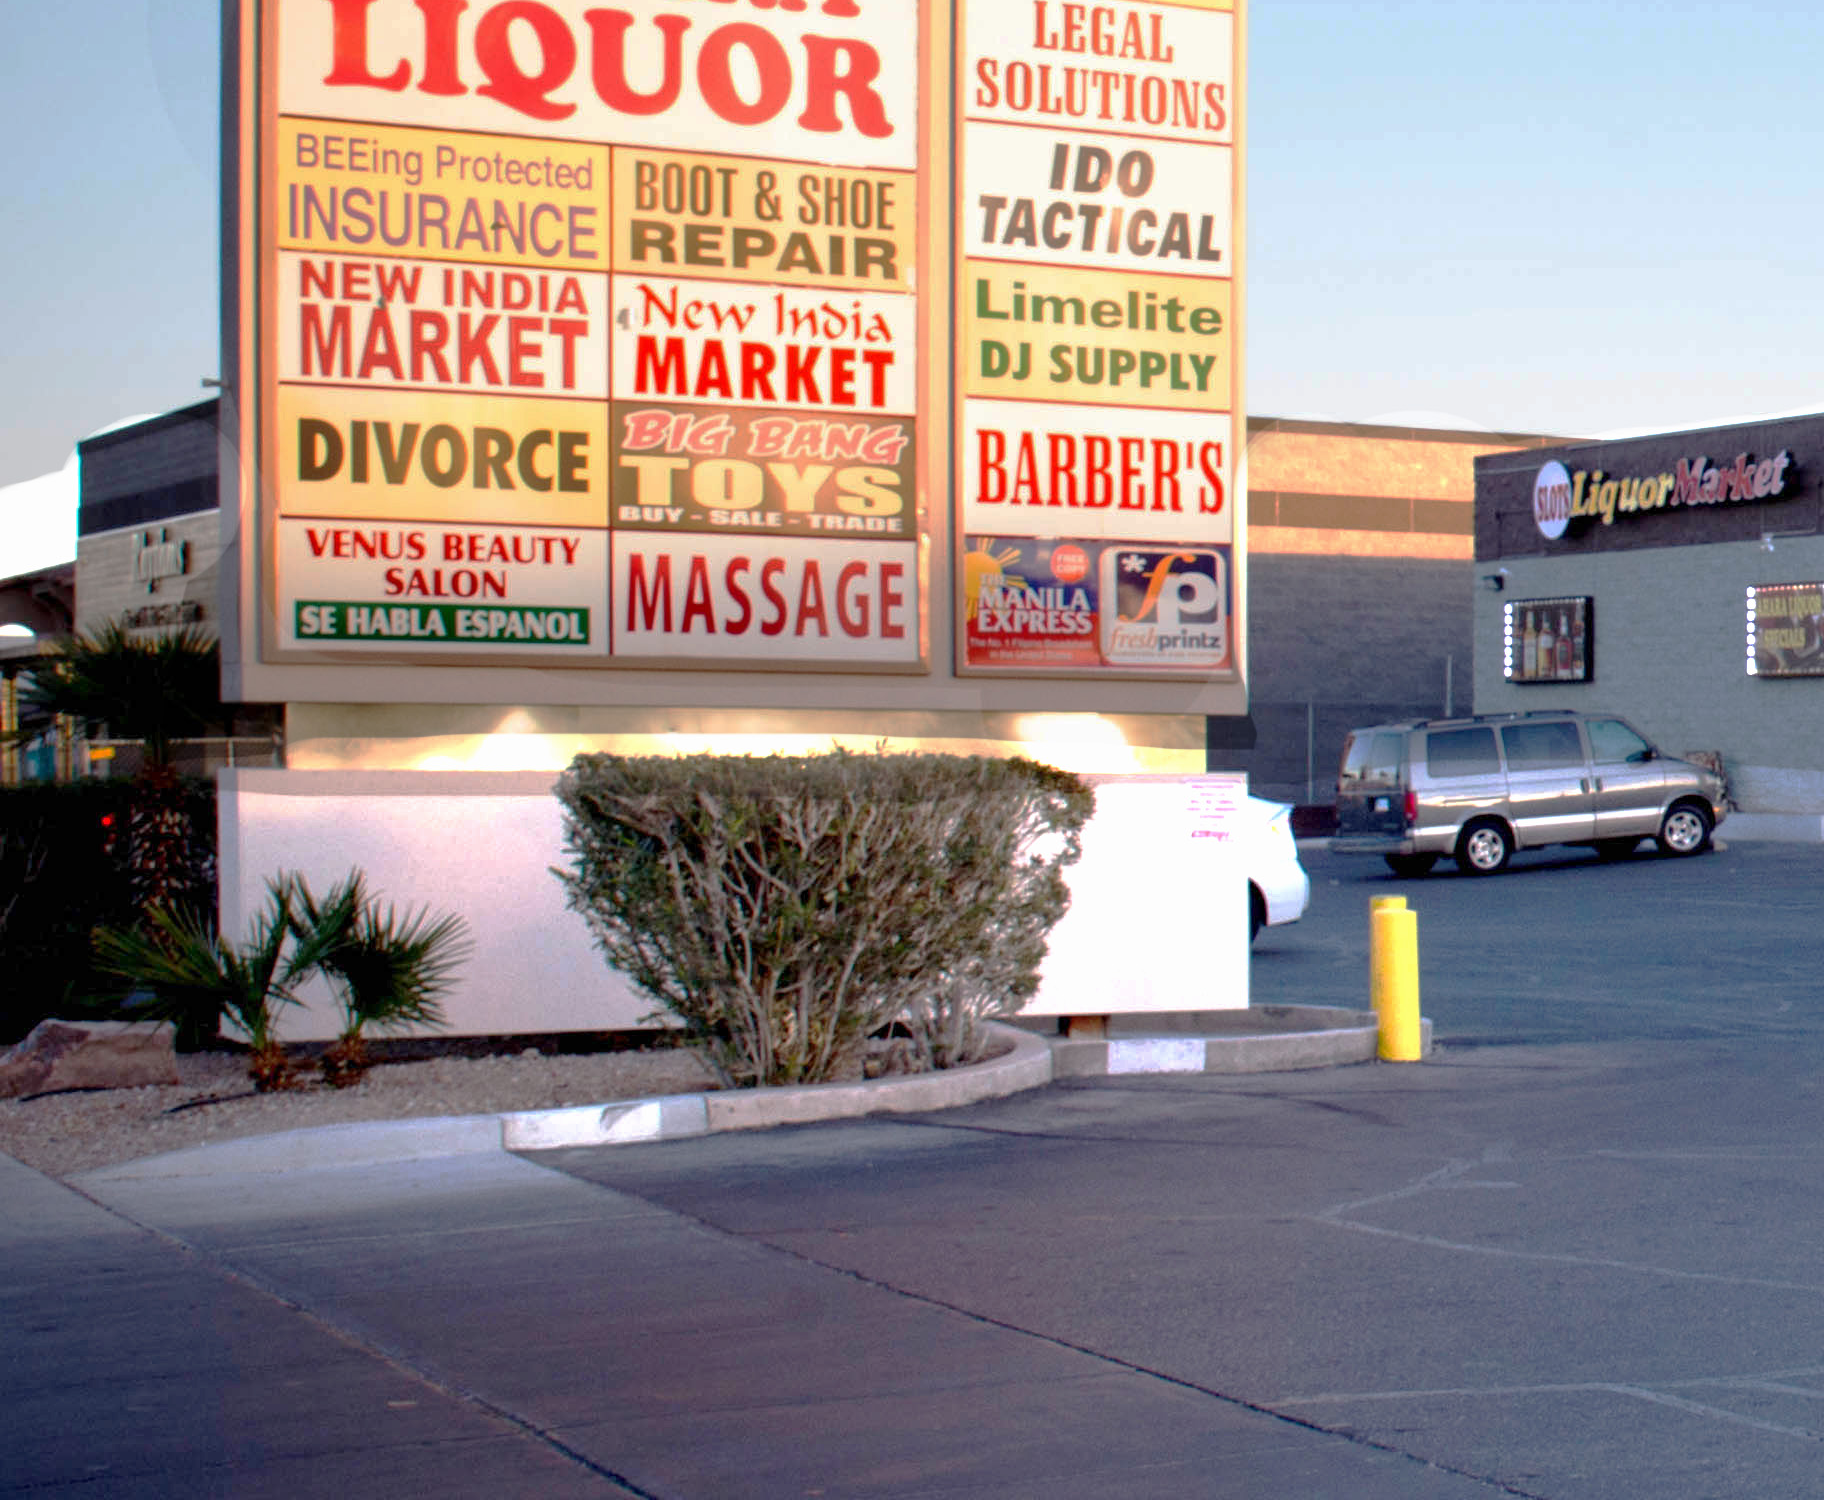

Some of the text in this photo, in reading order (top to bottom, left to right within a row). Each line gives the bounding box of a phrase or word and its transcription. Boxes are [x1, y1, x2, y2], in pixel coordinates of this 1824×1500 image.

[1033, 0, 1174, 63] LEGAL
[975, 57, 1227, 132] SOLUTIONS
[296, 134, 593, 191] BEEing Protected
[1048, 142, 1155, 198] IDO
[288, 183, 598, 260] INSURANCE
[635, 160, 895, 230] BOOT & SHOE
[629, 221, 899, 281] REPAIR
[978, 194, 1223, 263] TACTICAL
[300, 260, 588, 315] NEW INDIA
[637, 283, 892, 343] New India
[976, 277, 1223, 336] Limelite
[300, 303, 588, 389] MARKET
[634, 336, 894, 407] MARKET
[980, 340, 1217, 392] DJ SUPPLY
[299, 418, 590, 493] DIVORCE
[619, 409, 907, 464] BIG BANG
[618, 455, 903, 517] TOYS
[976, 428, 1226, 516] BARBER'S
[619, 504, 683, 524] BUY
[708, 509, 782, 529] SALE
[807, 514, 904, 534] TRADE
[1538, 483, 1571, 523] SLOTS
[306, 528, 580, 565] VENUS BEAUTY
[384, 567, 507, 598] SALON
[626, 552, 904, 638] MASSAGE
[979, 586, 1092, 611] MANILA
[301, 605, 585, 642] SE HABLA ESPANOL
[978, 609, 1094, 635] EXPRESS
